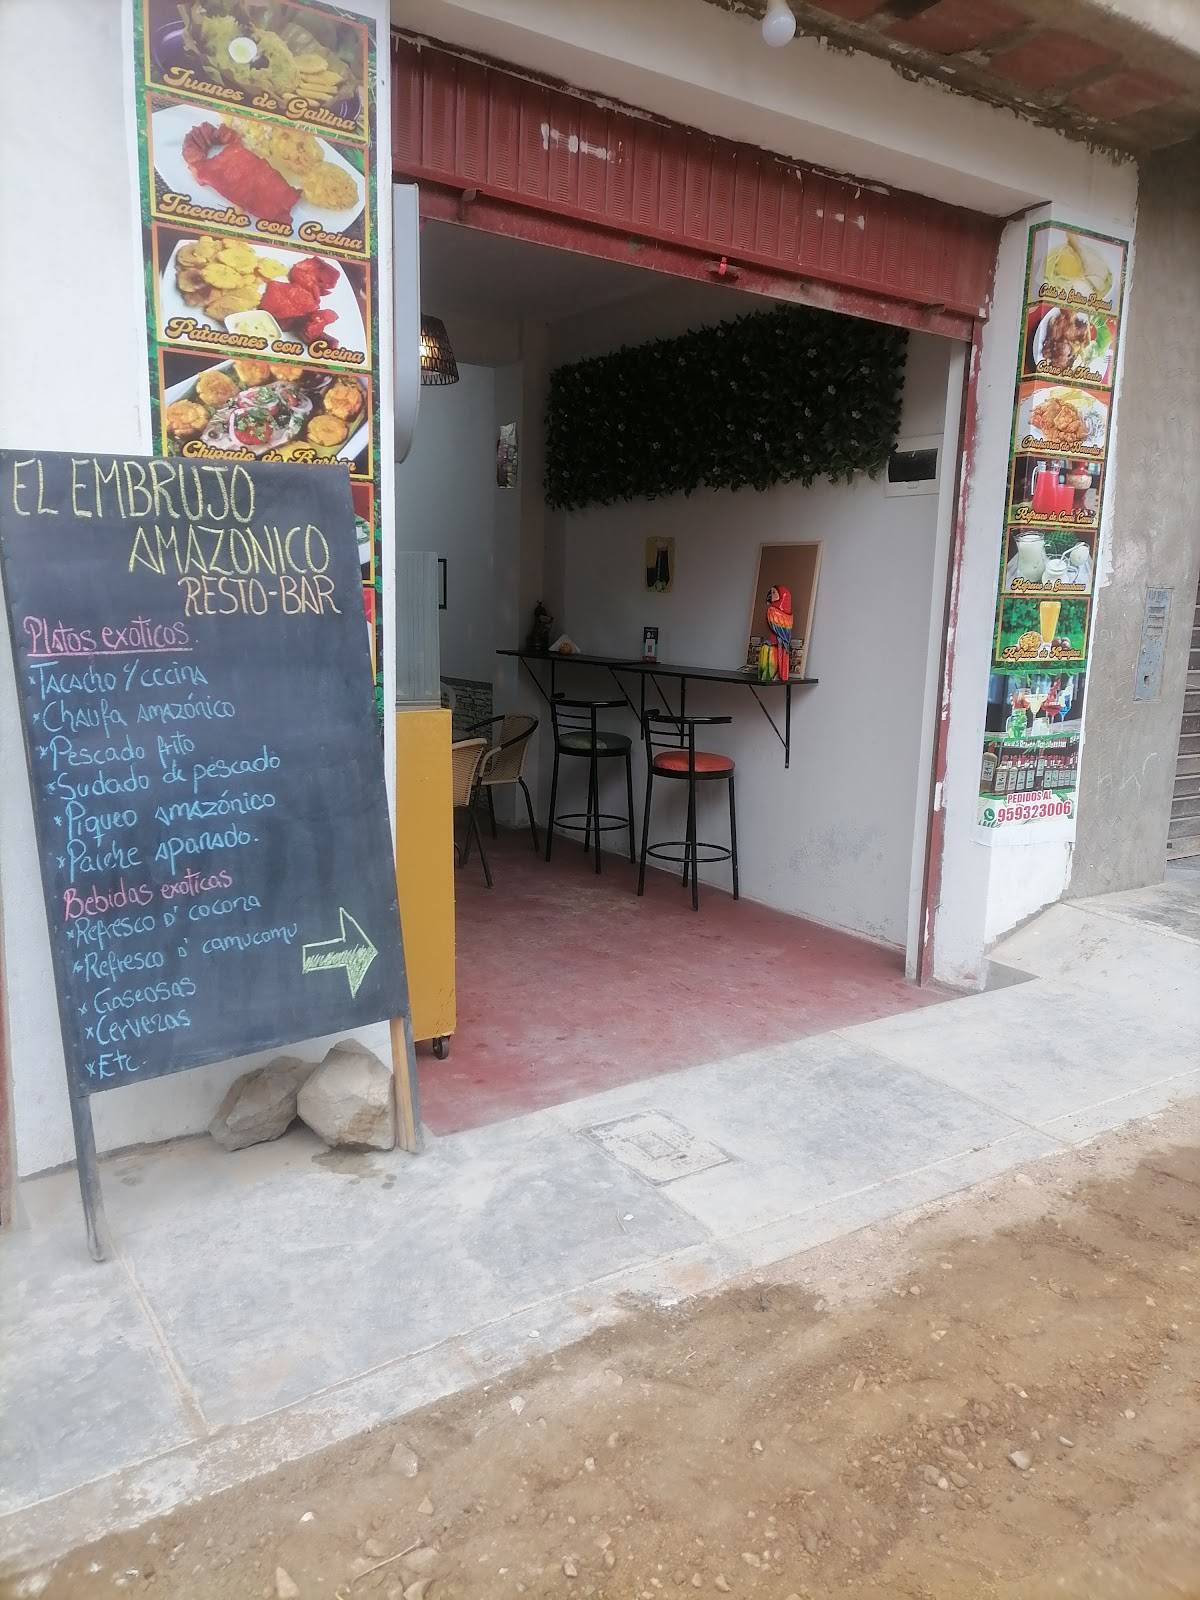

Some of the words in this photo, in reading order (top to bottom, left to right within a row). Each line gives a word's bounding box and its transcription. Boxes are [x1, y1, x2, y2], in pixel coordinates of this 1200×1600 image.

[163, 66, 245, 101] Juanes
[252, 91, 278, 110] de
[285, 96, 357, 131] Gallina
[159, 192, 250, 228] Tacacho
[256, 218, 293, 237] con
[299, 220, 364, 250] Cecina
[166, 317, 268, 350] Patacones
[271, 338, 304, 356] con
[308, 340, 365, 363] Cecina
[1036, 359, 1062, 375] Carne
[13, 459, 58, 517] EL
[71, 458, 256, 522] EMBRUJO
[128, 524, 330, 575] AMAZONICO
[177, 575, 342, 617] RESTO-BAR
[23, 615, 97, 653] Platos
[49, 734, 145, 771] Pescado
[157, 731, 196, 769] frito
[57, 764, 150, 800] Sudado
[193, 744, 281, 794] pescado
[998, 802, 1070, 821] 959323006
[1008, 792, 1041, 804] PEDIDOS
[1043, 790, 1053, 801] AL
[63, 877, 154, 921] Bebidas
[160, 867, 234, 900] exoticas
[75, 915, 155, 951] Refresco
[188, 895, 262, 921] cocona
[84, 951, 165, 983] Refresco
[94, 976, 197, 1014] Gaseosas
[96, 1008, 192, 1046] Cervezas
